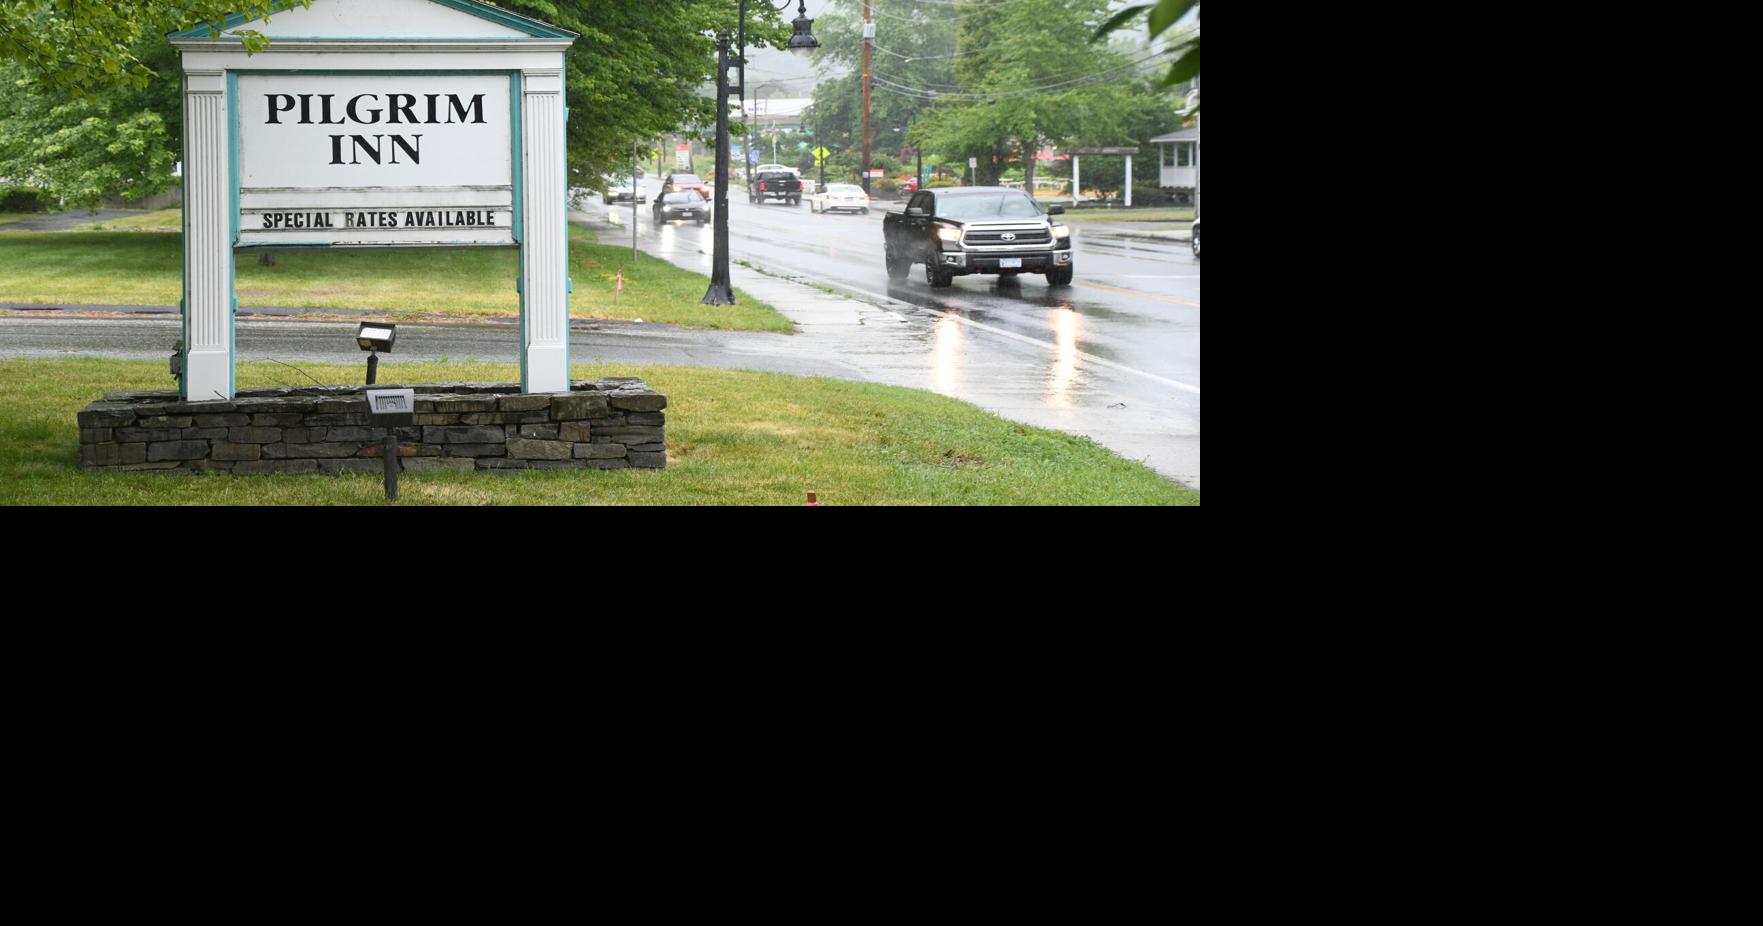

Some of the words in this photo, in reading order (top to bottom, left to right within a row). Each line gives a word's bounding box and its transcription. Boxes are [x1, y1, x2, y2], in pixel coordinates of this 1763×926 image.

[264, 93, 487, 124] PILGRIM
[328, 134, 423, 165] INN
[263, 212, 333, 228] SPECIAL
[345, 211, 398, 227] RATES
[405, 210, 495, 226] AVAILABLE
